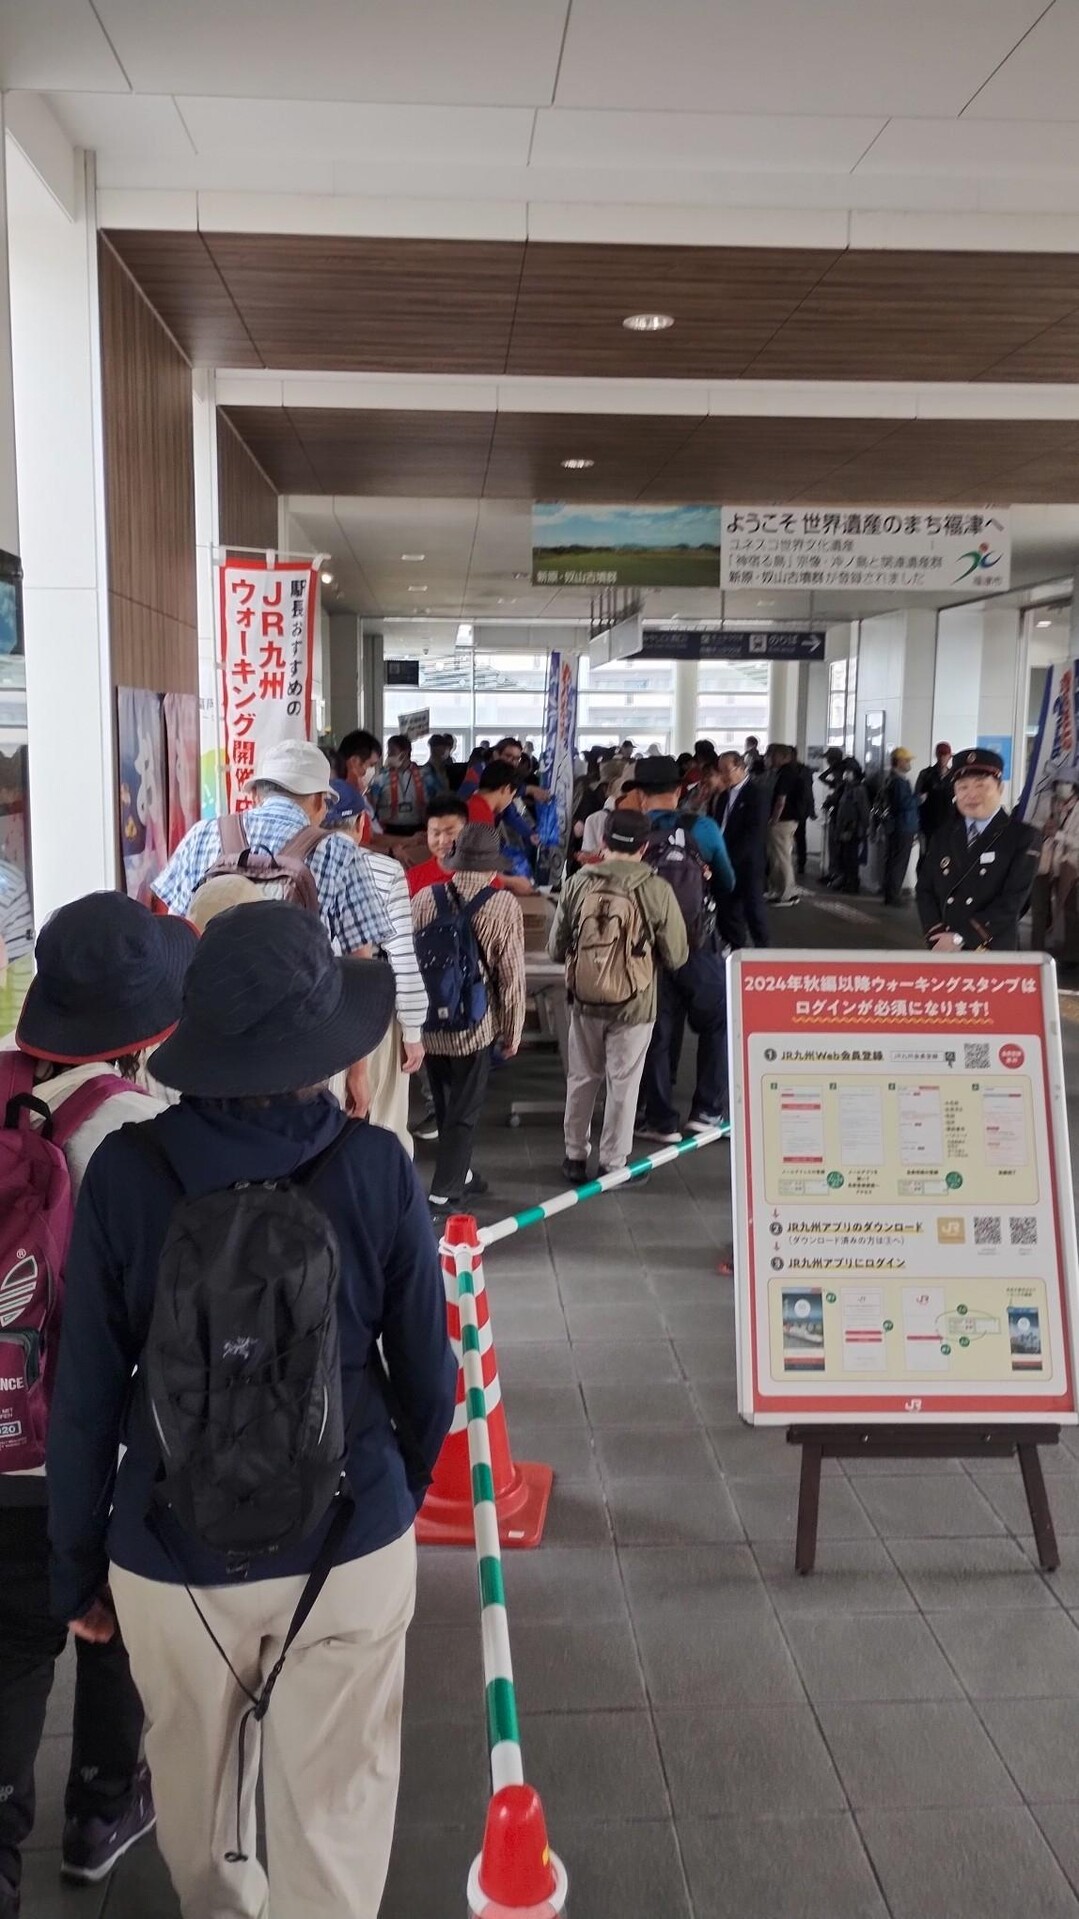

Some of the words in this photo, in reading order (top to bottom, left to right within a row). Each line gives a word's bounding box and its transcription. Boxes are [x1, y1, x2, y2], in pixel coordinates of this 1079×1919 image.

[259, 582, 286, 699] JR九州
[287, 580, 306, 716] 駅長おすすめの
[787, 1221, 923, 1233] JR九州アプリのダウンロード
[788, 1257, 906, 1269] JR九州アプリにログイン
